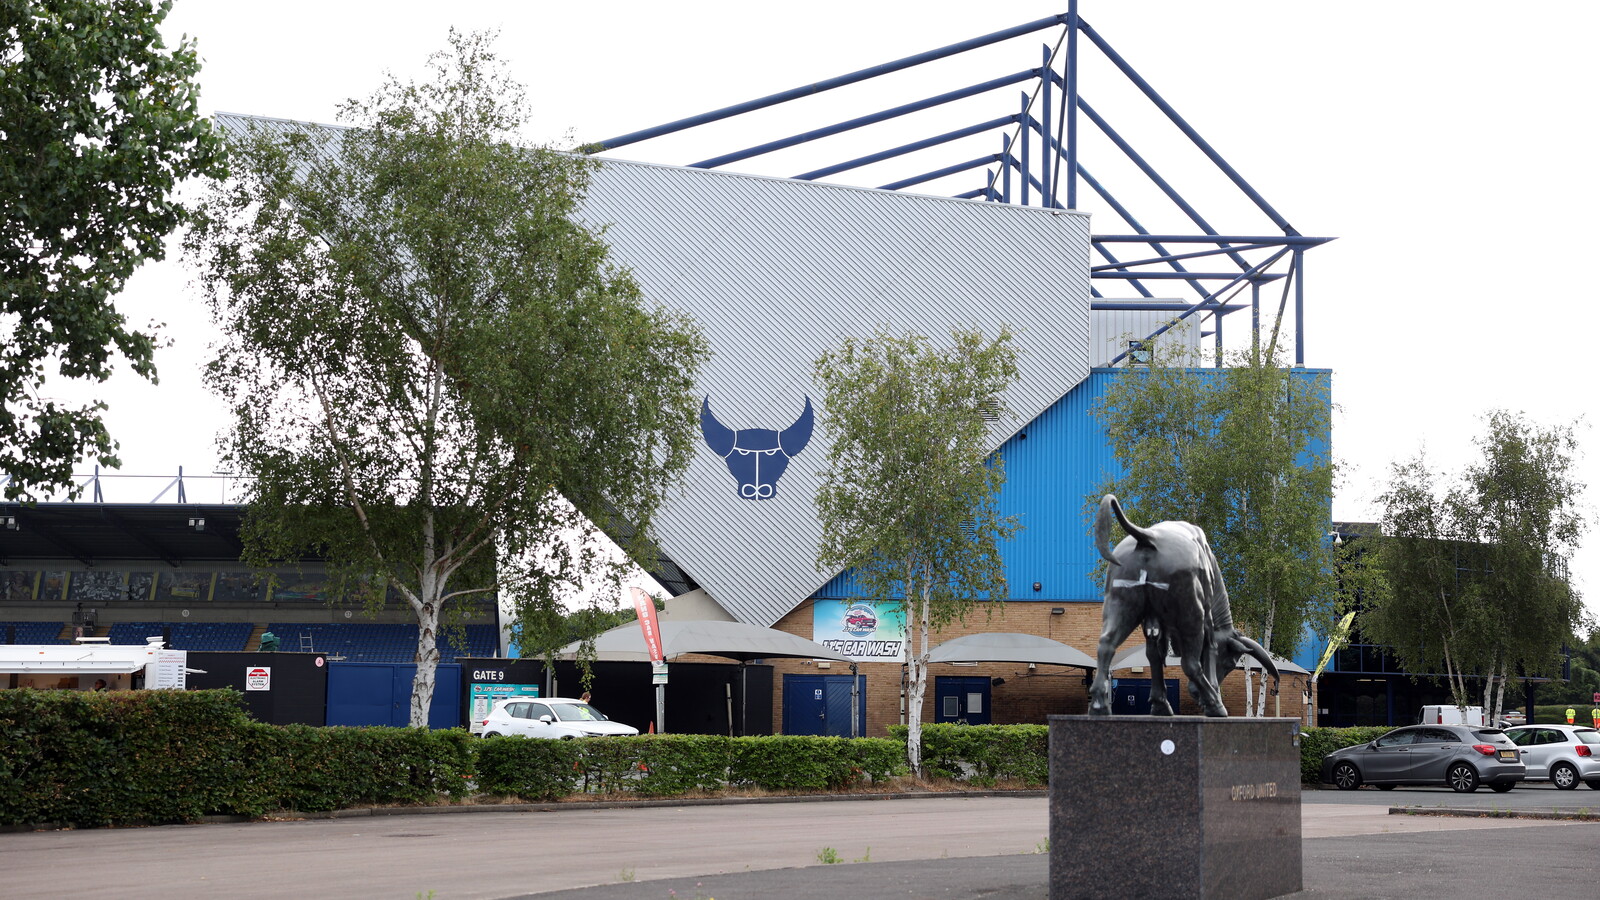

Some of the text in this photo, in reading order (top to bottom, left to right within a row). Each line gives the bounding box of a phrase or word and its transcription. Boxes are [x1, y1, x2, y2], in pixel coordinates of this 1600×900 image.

[843, 640, 866, 656] CAR
[866, 640, 902, 657] WASH
[473, 670, 504, 680] GATE 9
[1231, 782, 1277, 801] OXFORD UNITED
